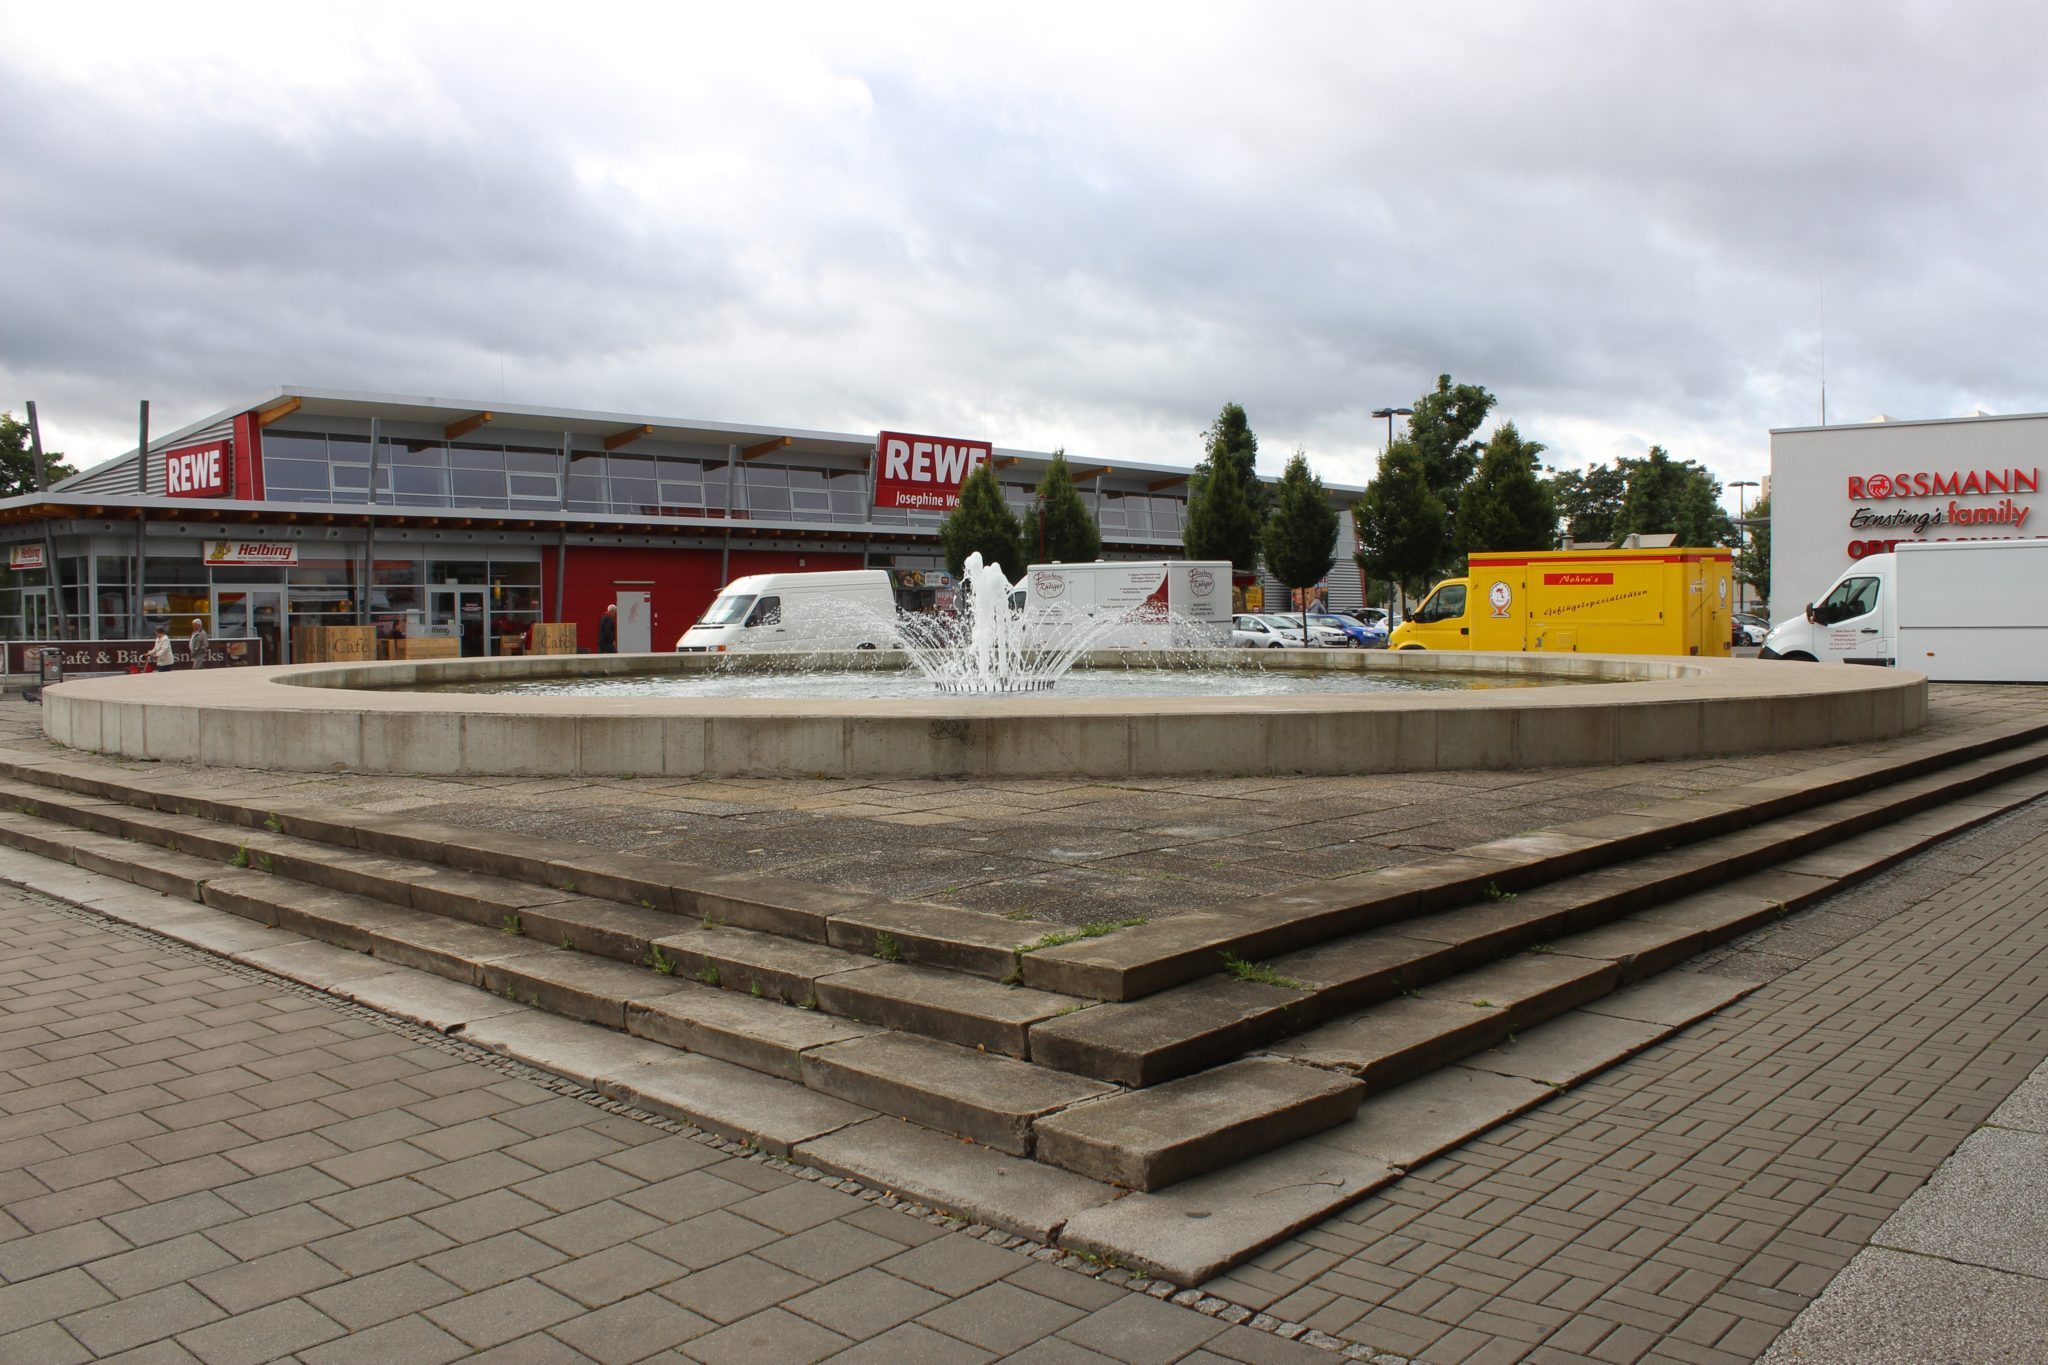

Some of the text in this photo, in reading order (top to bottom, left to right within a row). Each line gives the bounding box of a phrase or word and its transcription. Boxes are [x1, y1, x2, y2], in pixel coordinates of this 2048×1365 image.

[169, 450, 221, 493] REWE
[885, 440, 987, 485] REWE
[1848, 468, 2038, 499] ROSSMANN
[896, 491, 943, 507] Josephine
[1850, 499, 2030, 533] Ernsting's family
[238, 544, 292, 560] Helbing
[1544, 589, 1648, 616] Geflügelspezialitäten
[334, 638, 369, 654] Café
[540, 634, 571, 649] Café
[96, 651, 111, 664] &
